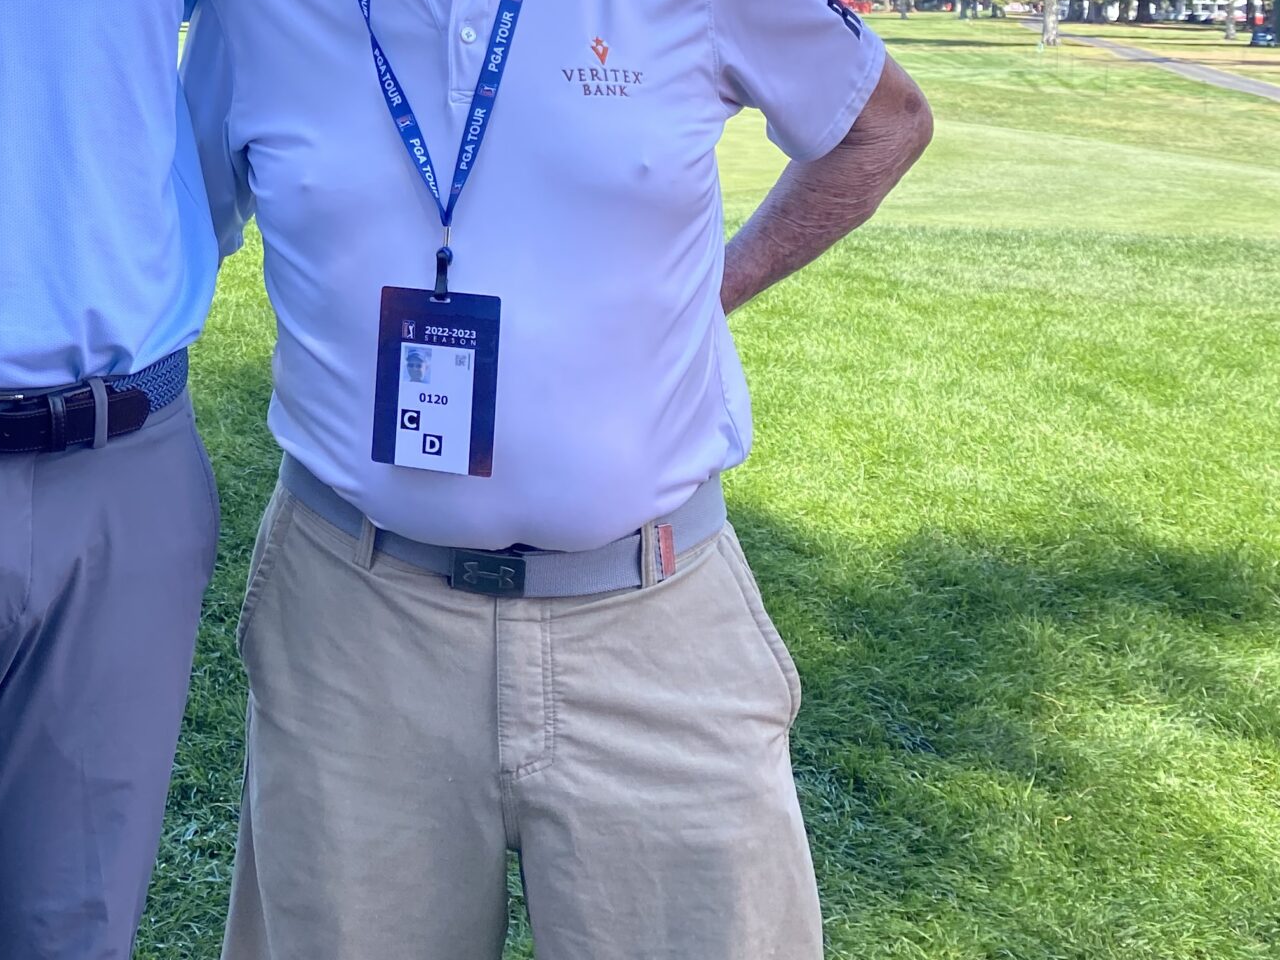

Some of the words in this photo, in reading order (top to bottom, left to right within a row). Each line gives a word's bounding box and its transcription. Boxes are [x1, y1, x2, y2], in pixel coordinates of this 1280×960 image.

[496, 11, 515, 44] TOUR
[488, 47, 505, 72] PGA
[373, 48, 387, 75] PGA
[382, 72, 402, 107] TOUR
[561, 67, 642, 84] VERITEX
[582, 83, 630, 97] BANK
[467, 108, 487, 141] TOUR
[410, 138, 427, 164] PGA
[459, 144, 476, 170] PGA
[424, 334, 477, 346] SEASON
[425, 326, 477, 339] 2022-2023
[419, 392, 448, 406] 0120
[403, 411, 418, 429] C
[424, 435, 441, 453] D
